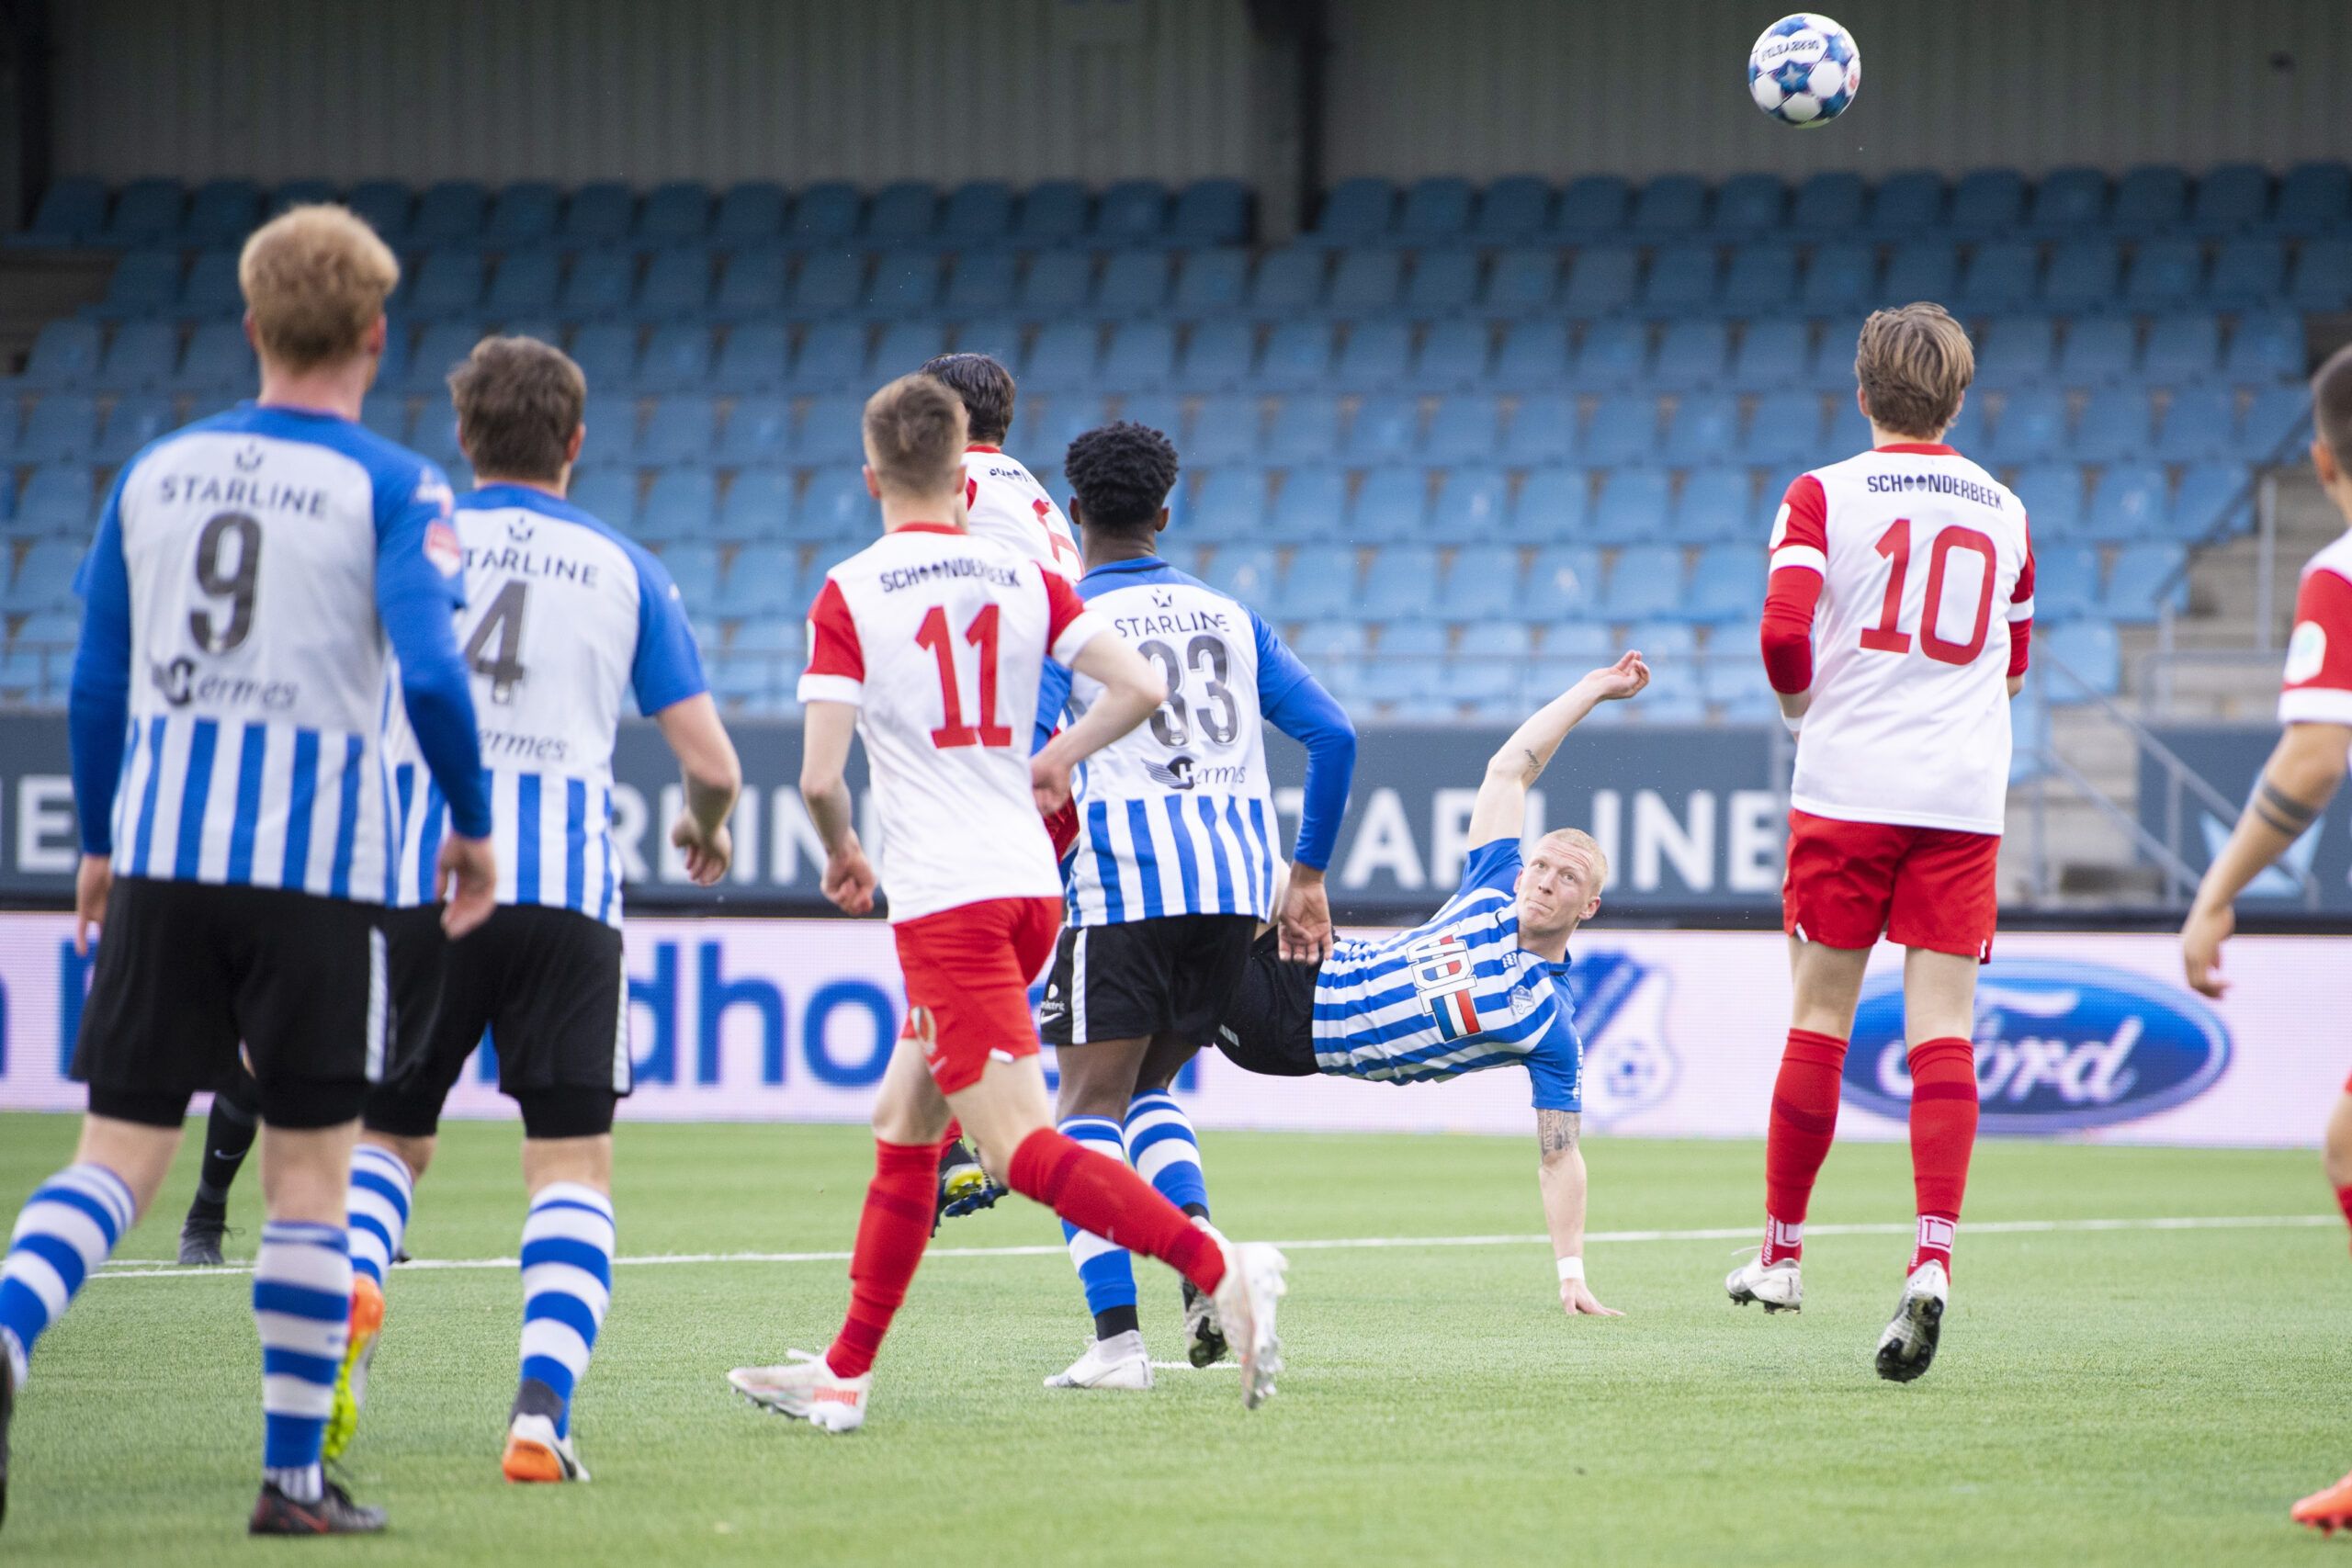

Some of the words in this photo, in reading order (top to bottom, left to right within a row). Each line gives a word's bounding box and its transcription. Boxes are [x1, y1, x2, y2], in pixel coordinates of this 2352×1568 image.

[160, 476, 329, 517] STARLINE
[189, 511, 262, 656] 9
[462, 546, 599, 587] TARLINE
[1860, 518, 1997, 666] 10
[465, 579, 528, 705] 4
[1114, 611, 1230, 637] STARLINE
[915, 604, 1013, 749] 11
[1137, 635, 1241, 749] 33
[479, 730, 569, 761] ermes
[1407, 921, 1478, 1016] VDL
